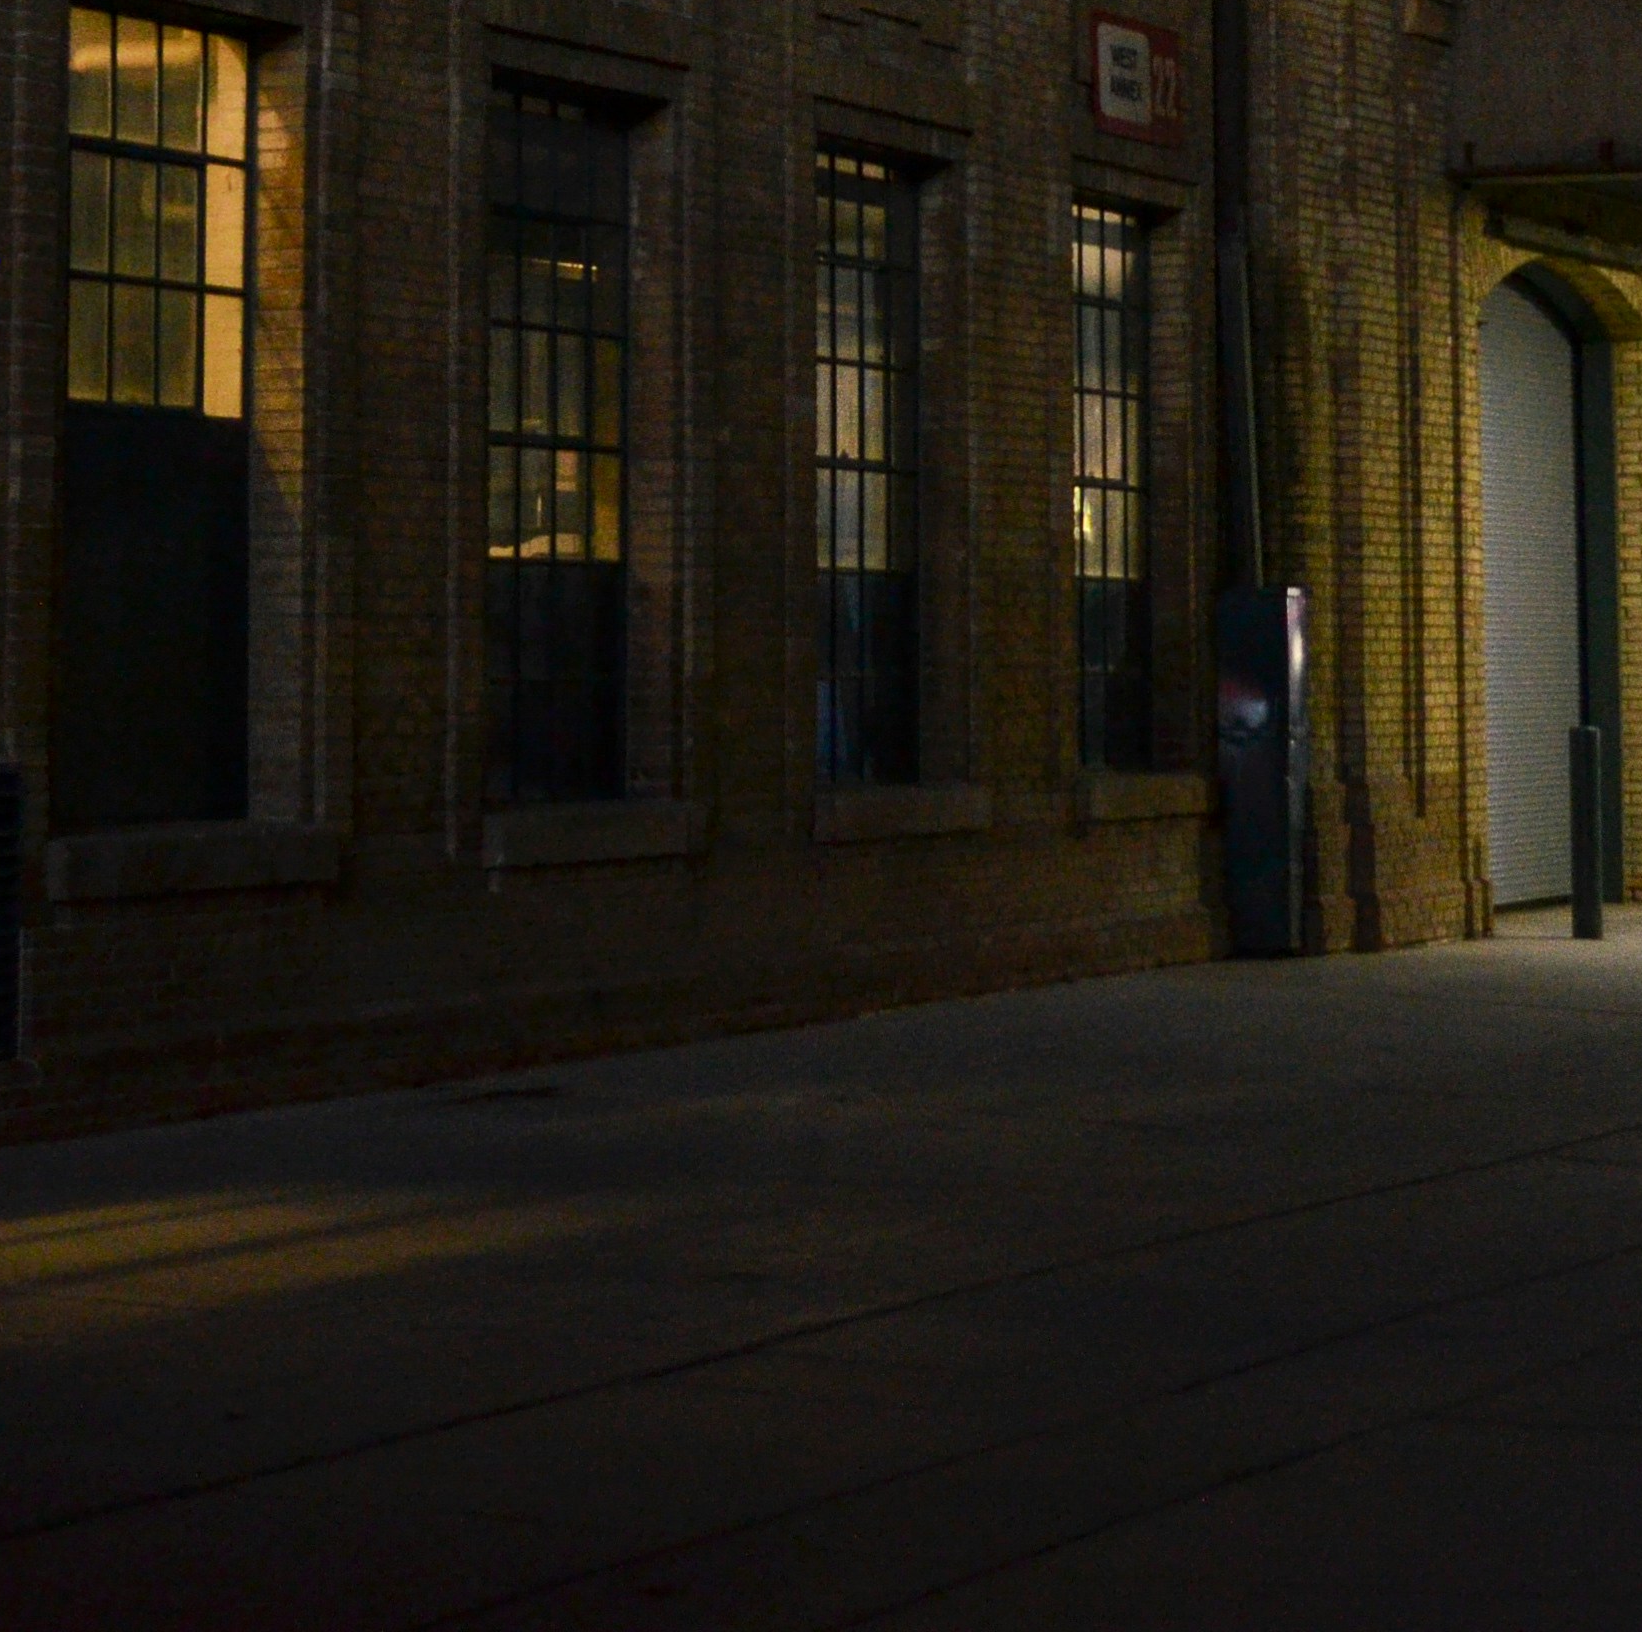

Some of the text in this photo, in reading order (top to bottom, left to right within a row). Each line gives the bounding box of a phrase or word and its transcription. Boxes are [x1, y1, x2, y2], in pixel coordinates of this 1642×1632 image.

[1109, 44, 1138, 70] WEST
[1110, 75, 1143, 102] ANNEX
[1152, 54, 1177, 118] 22
